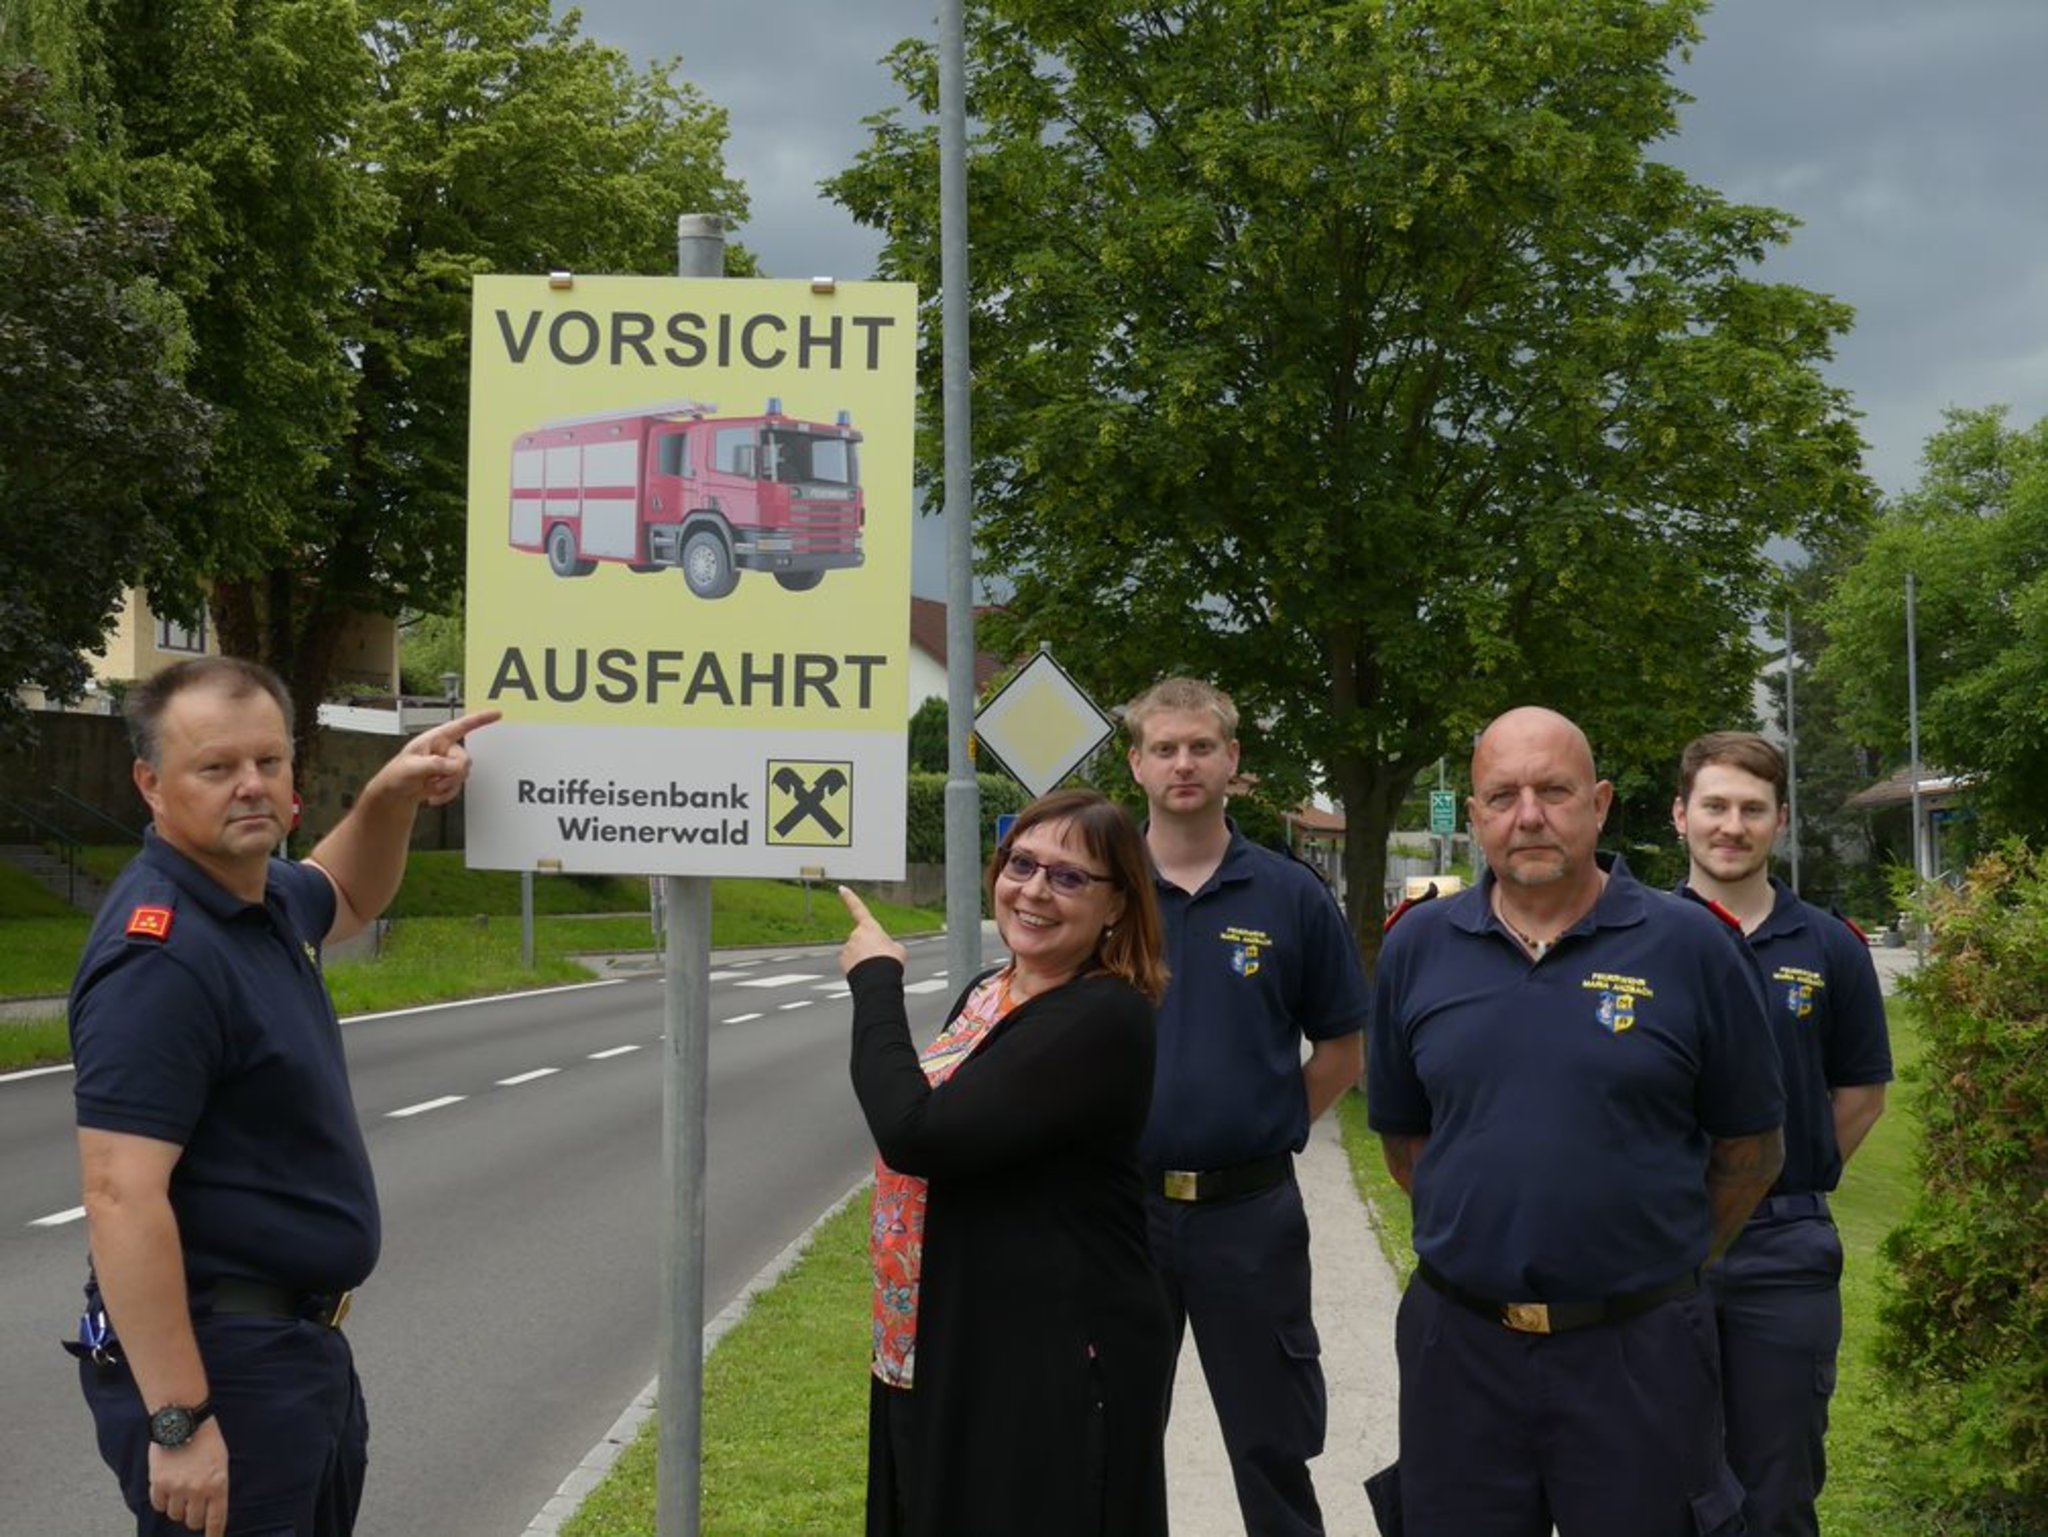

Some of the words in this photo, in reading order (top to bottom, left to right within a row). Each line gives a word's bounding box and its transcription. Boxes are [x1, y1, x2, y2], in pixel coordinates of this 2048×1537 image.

[494, 309, 895, 370] VORSICHT
[487, 647, 887, 709] AUSFAHRT
[518, 779, 749, 809] Raiffeisenbank
[557, 816, 749, 846] Wienerwald
